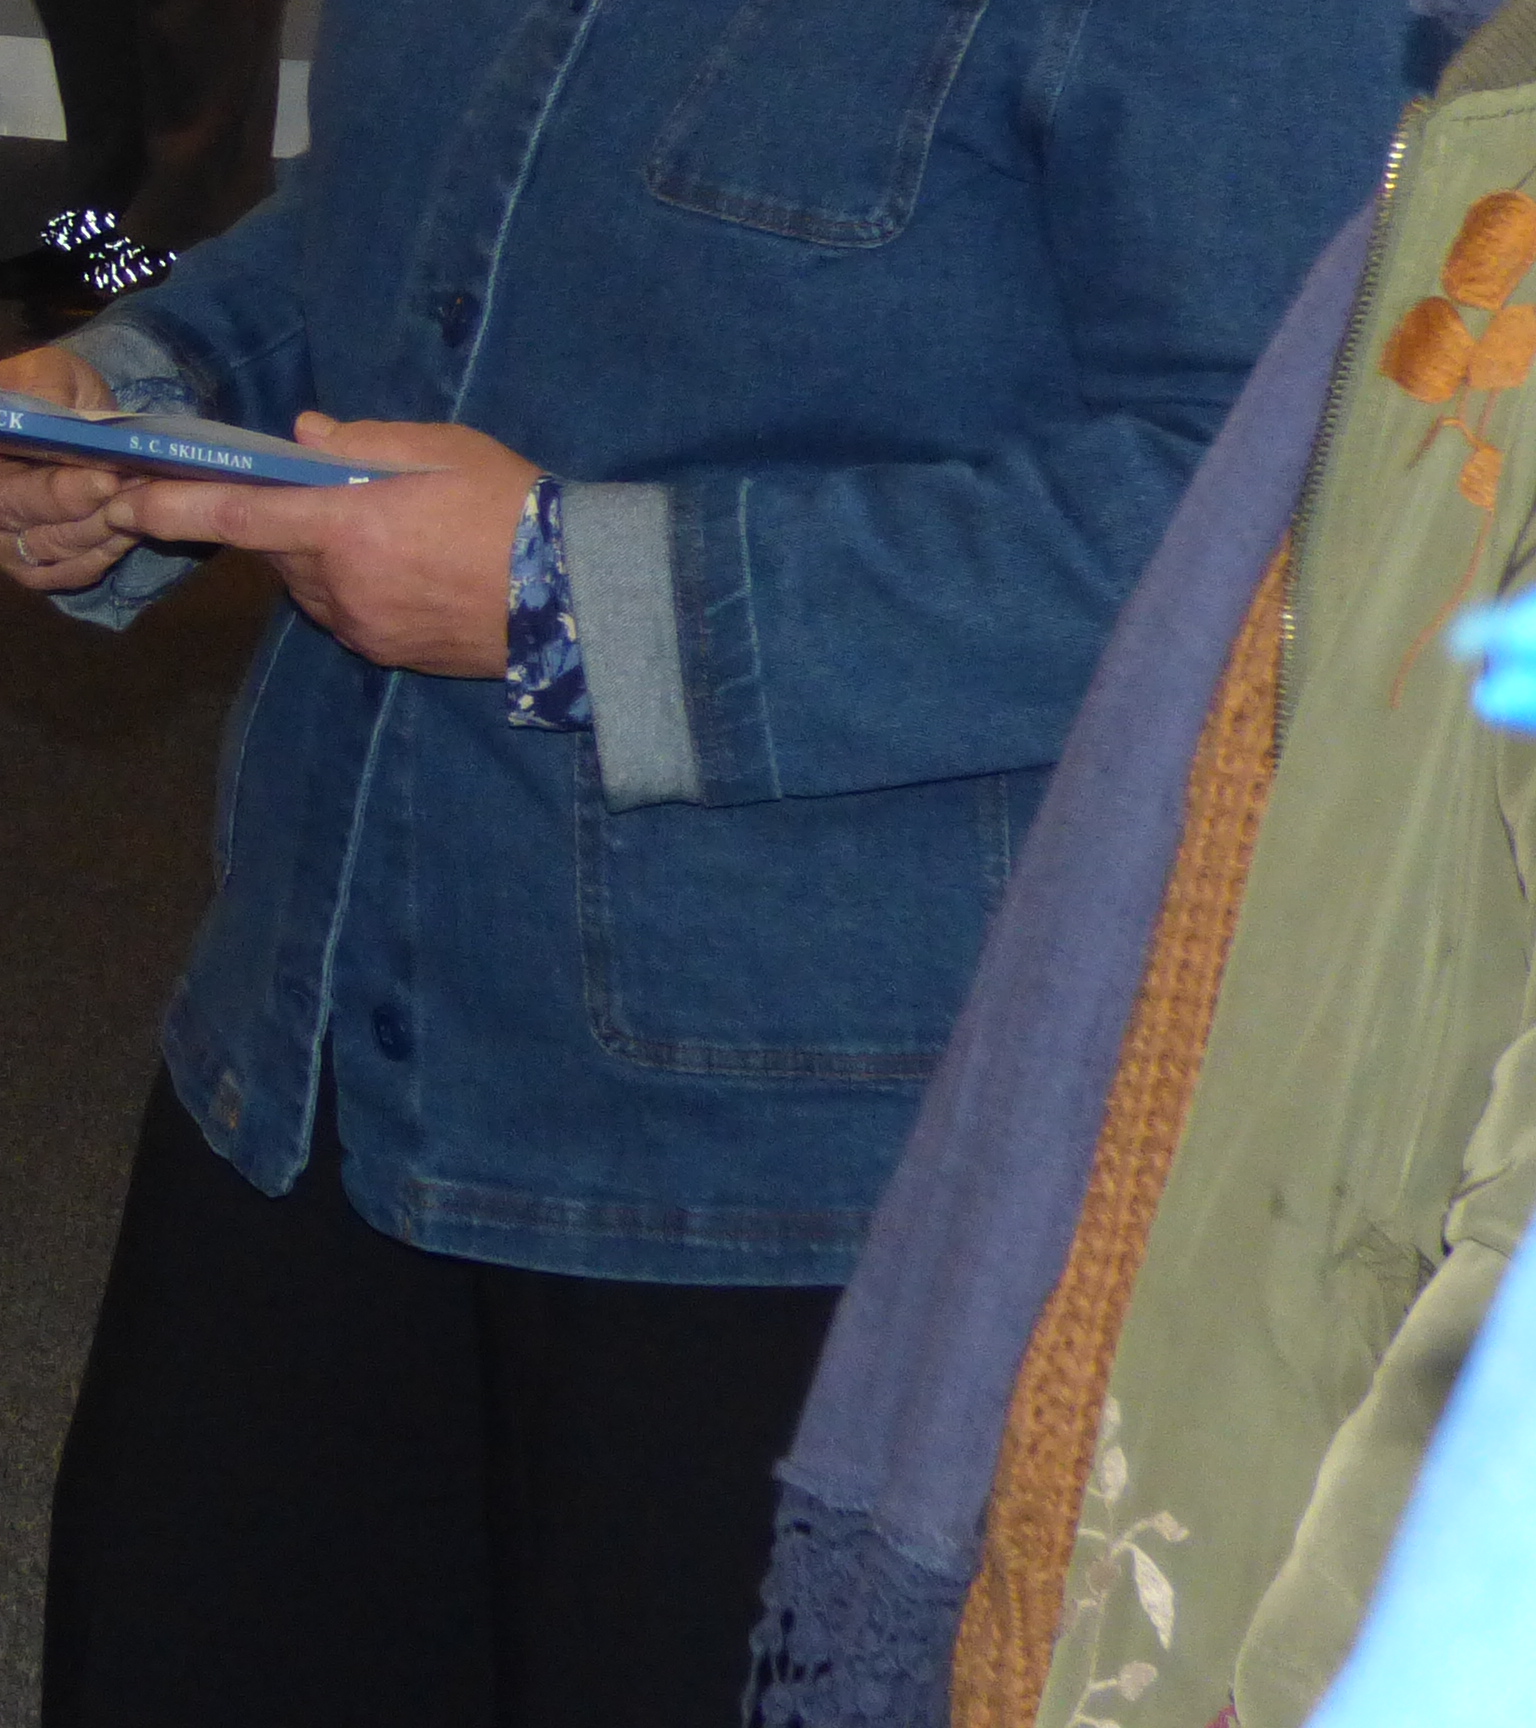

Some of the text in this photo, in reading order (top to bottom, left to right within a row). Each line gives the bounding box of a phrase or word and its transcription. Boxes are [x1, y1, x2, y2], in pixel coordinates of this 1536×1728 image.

[129, 435, 254, 470] S. C. SKILLMAN
